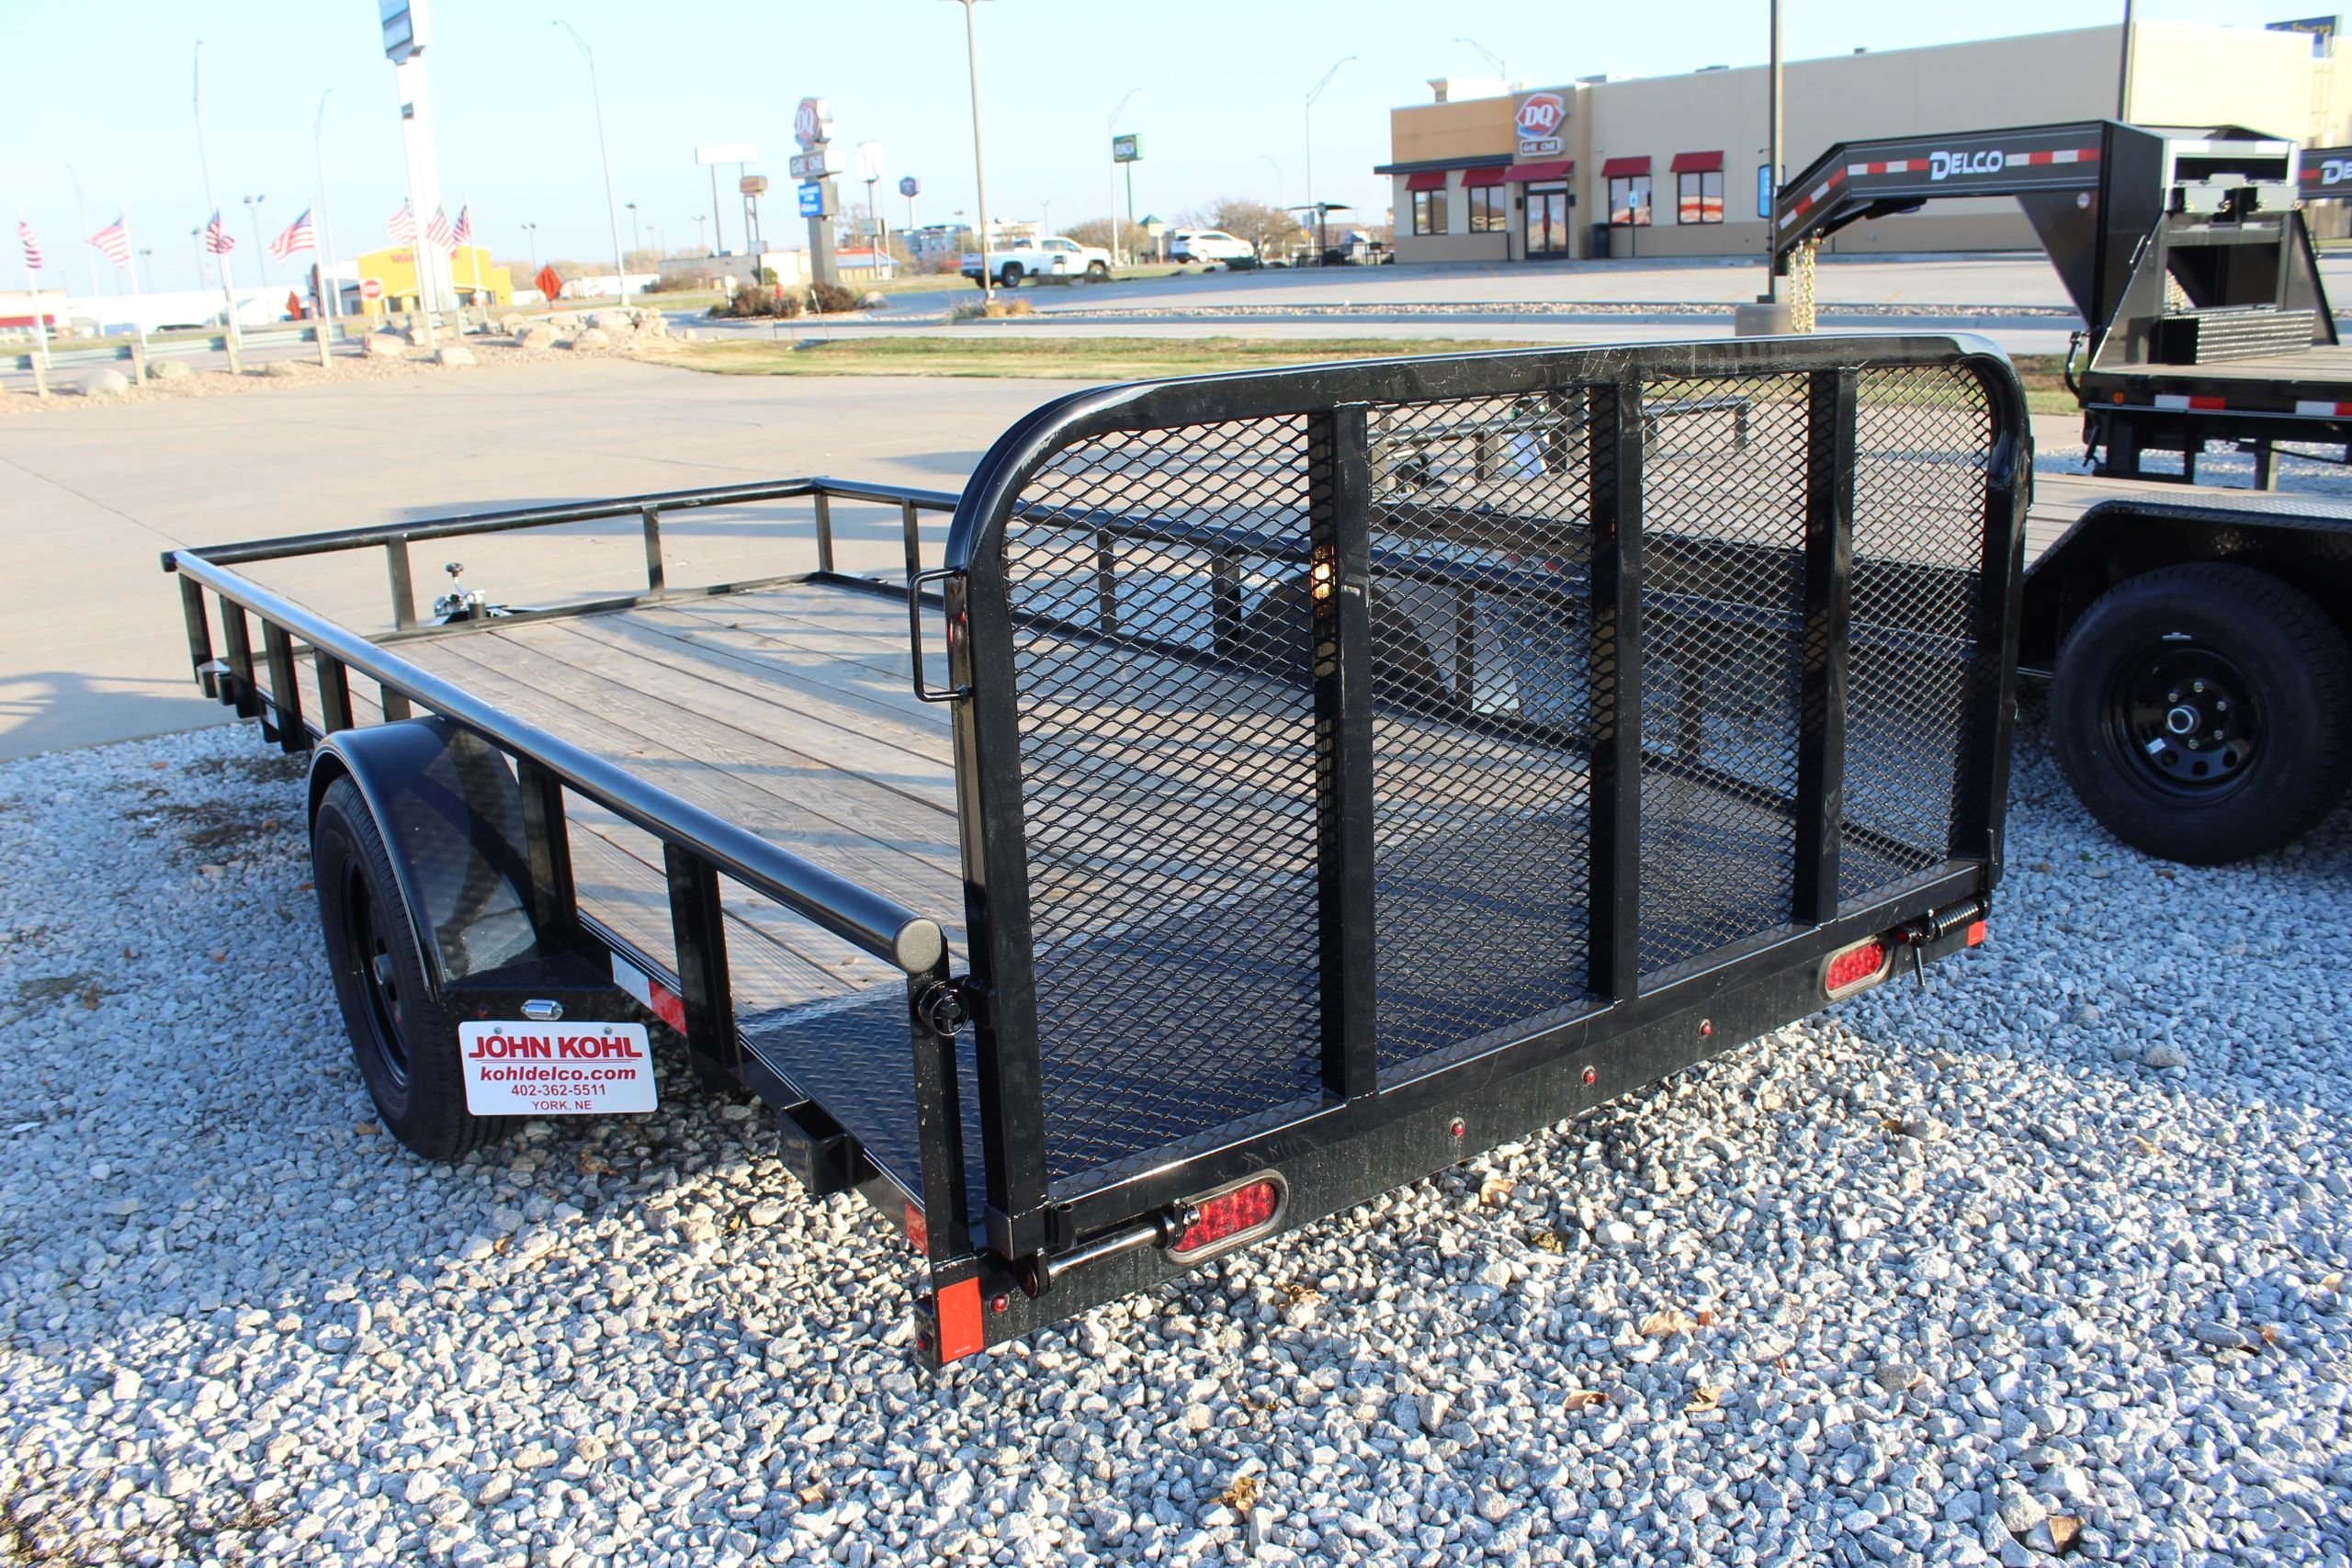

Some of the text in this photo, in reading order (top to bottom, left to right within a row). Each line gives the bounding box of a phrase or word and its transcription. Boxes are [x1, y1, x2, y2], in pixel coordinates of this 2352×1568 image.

[795, 108, 815, 134] DQ
[1524, 104, 1555, 127] DQ
[1929, 150, 2004, 180] DELCO
[469, 1036, 643, 1058] JOHN KOHL
[481, 1066, 637, 1081] kohldelco.com
[511, 1084, 606, 1097] 402-362-5511
[531, 1100, 593, 1112] YORK, NE
